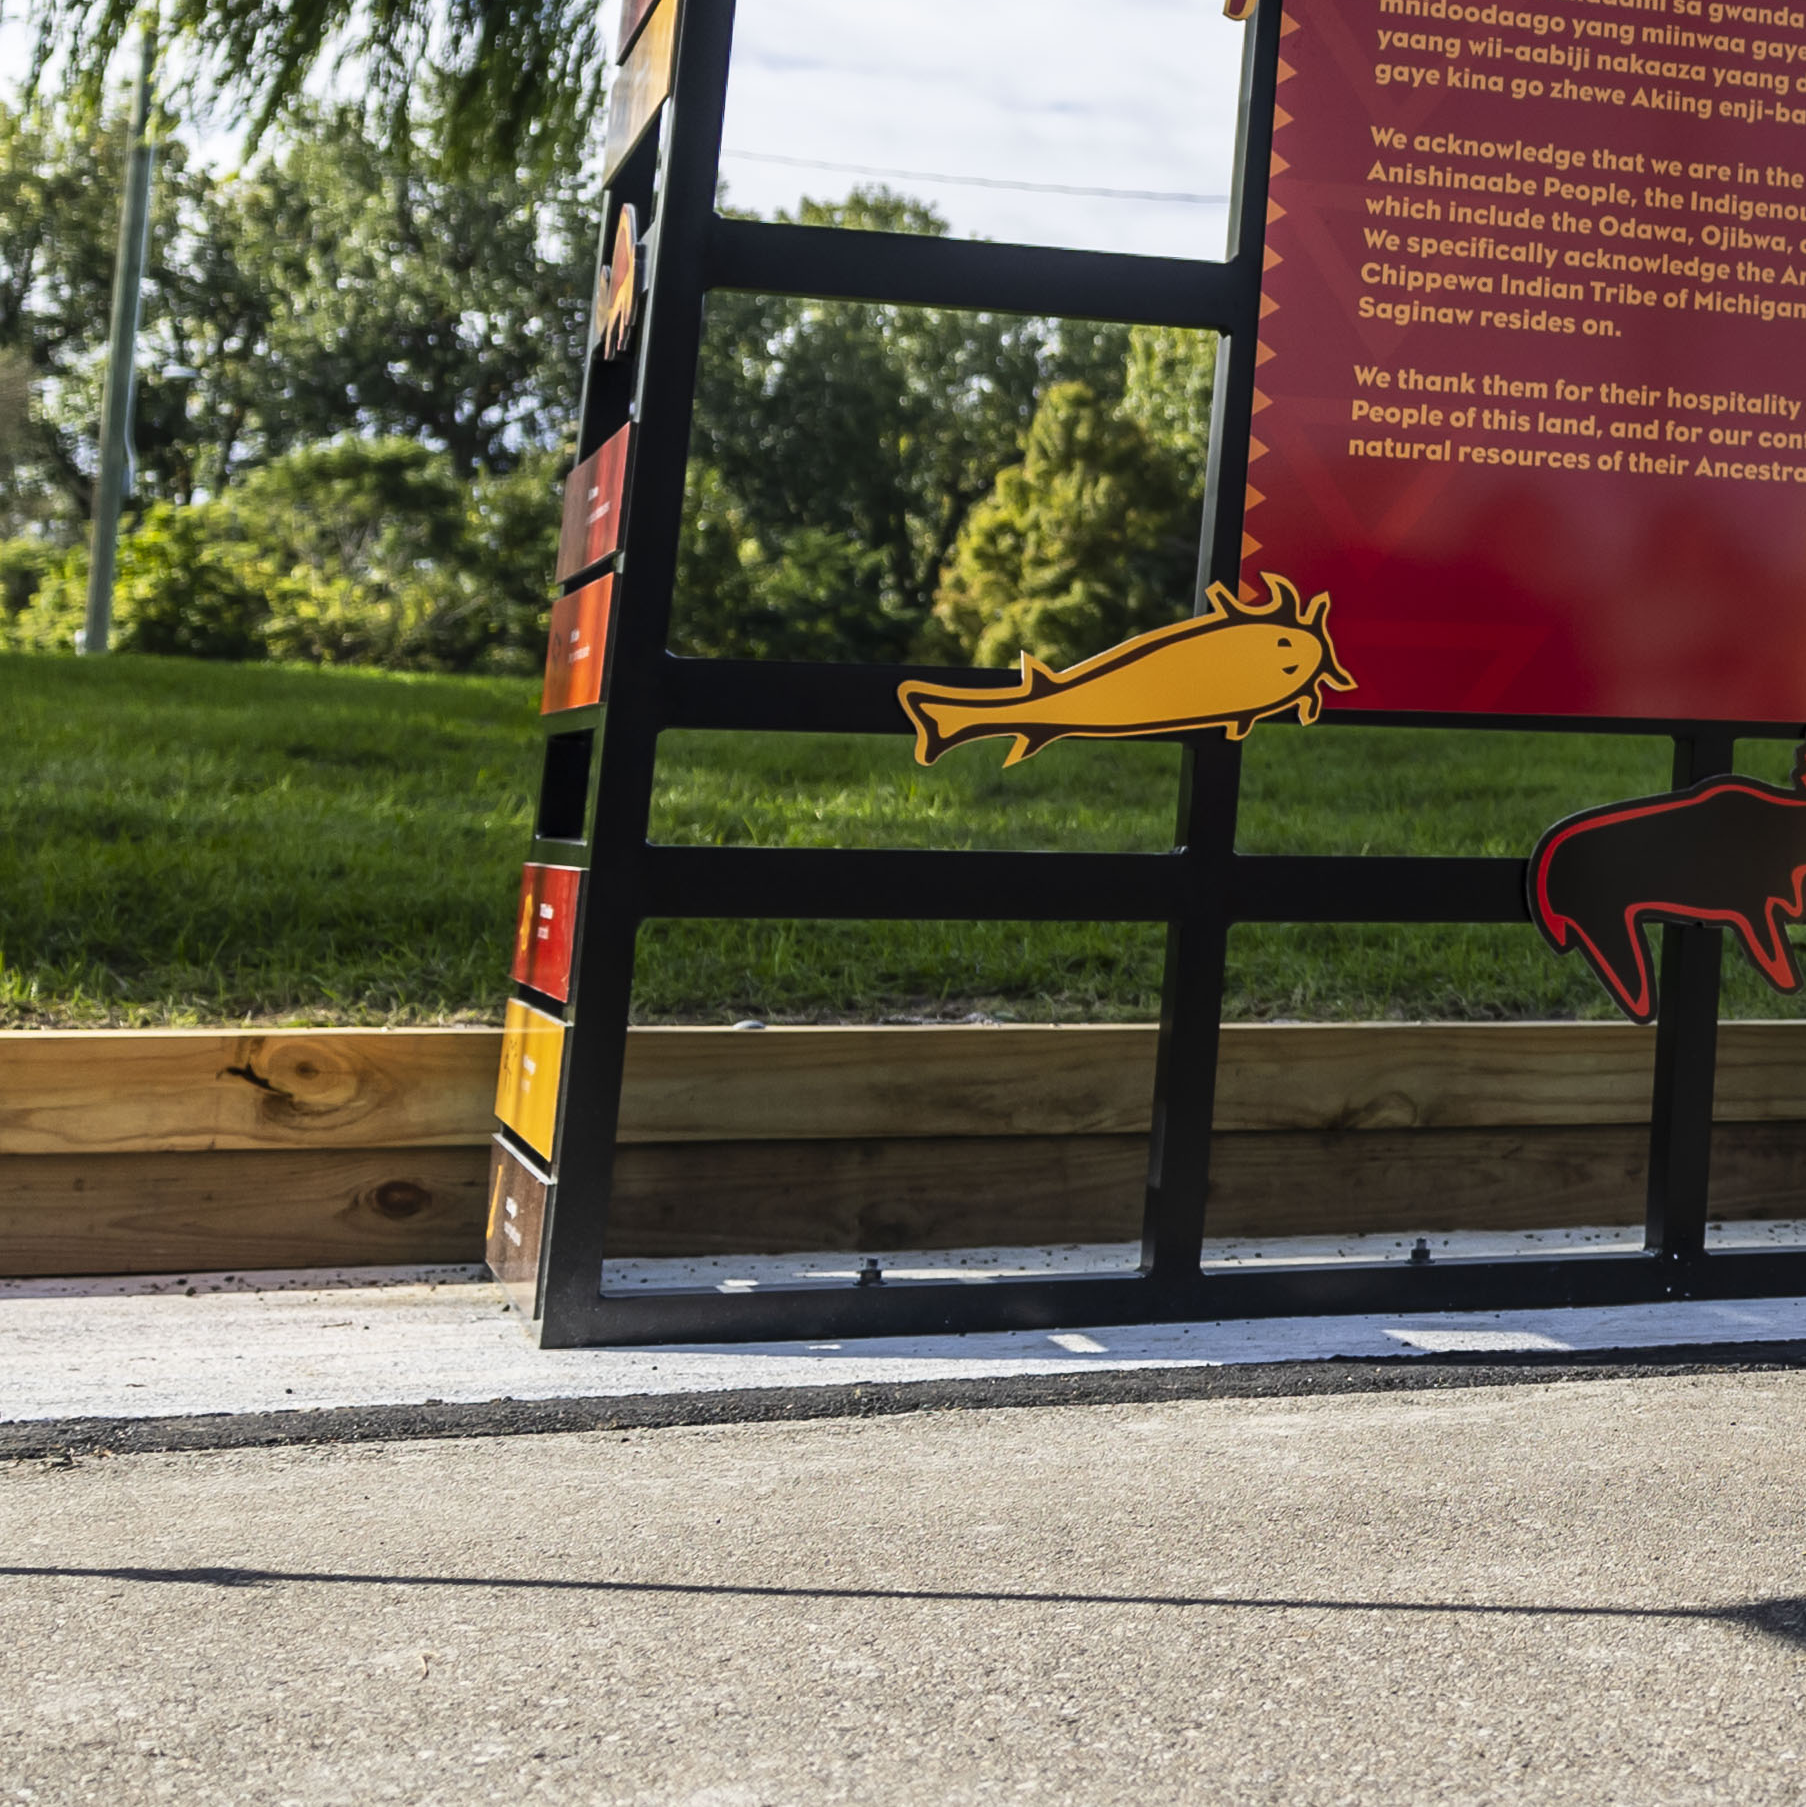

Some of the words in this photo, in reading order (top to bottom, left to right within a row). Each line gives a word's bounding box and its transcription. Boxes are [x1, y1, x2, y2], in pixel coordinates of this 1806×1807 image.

[1571, 18, 1635, 46] yang
[1641, 24, 1746, 54] miinwaa
[1708, 2, 1805, 29] gwanda
[1377, 29, 1461, 59] yaang
[1467, 36, 1591, 72] wii-aabiji
[1596, 53, 1707, 82] nakaaza
[1712, 67, 1790, 96] yaang
[1374, 63, 1441, 88] gaye
[1446, 65, 1504, 93] kina
[1510, 78, 1544, 100] go
[1549, 78, 1626, 106] zhewe
[1630, 86, 1713, 120] Akiing
[1370, 125, 1408, 150] We
[1413, 133, 1587, 171] acknowledge
[1591, 148, 1645, 174] that
[1650, 158, 1683, 177] we
[1687, 162, 1732, 182] are
[1737, 162, 1760, 185] in
[1765, 166, 1805, 189] the
[1366, 159, 1538, 196] Anishinaabe
[1543, 176, 1638, 208] People,
[1643, 186, 1685, 210] the
[1365, 194, 1442, 221] which
[1448, 200, 1546, 231] include
[1551, 211, 1593, 235] the
[1598, 214, 1695, 246] Odawa,
[1700, 224, 1793, 255] Ojibwa,
[1363, 227, 1401, 252] We
[1406, 236, 1559, 270] specifically
[1563, 247, 1731, 284] acknowledge
[1735, 260, 1776, 284] the
[1360, 261, 1494, 294] Chippewa
[1500, 273, 1584, 301] Indian
[1589, 280, 1658, 307] Tribe
[1662, 288, 1690, 309] of
[1357, 296, 1474, 326] Saginaw
[1479, 308, 1576, 334] resides
[1581, 318, 1622, 338] on.
[1353, 364, 1392, 389] We
[1397, 368, 1476, 395] thank
[1481, 374, 1549, 400] them
[1554, 378, 1594, 402] for
[1599, 382, 1662, 407] their
[1667, 386, 1802, 421] hospitality
[1351, 399, 1444, 429] People
[1449, 406, 1478, 429] of
[1481, 408, 1531, 433] this
[1537, 411, 1603, 439] land,
[1609, 418, 1660, 441] and
[1665, 419, 1704, 443] for
[1708, 427, 1753, 447] our
[1348, 437, 1452, 462] natural
[1458, 445, 1591, 470] resources
[1596, 449, 1624, 472] of
[1627, 451, 1690, 476] their
